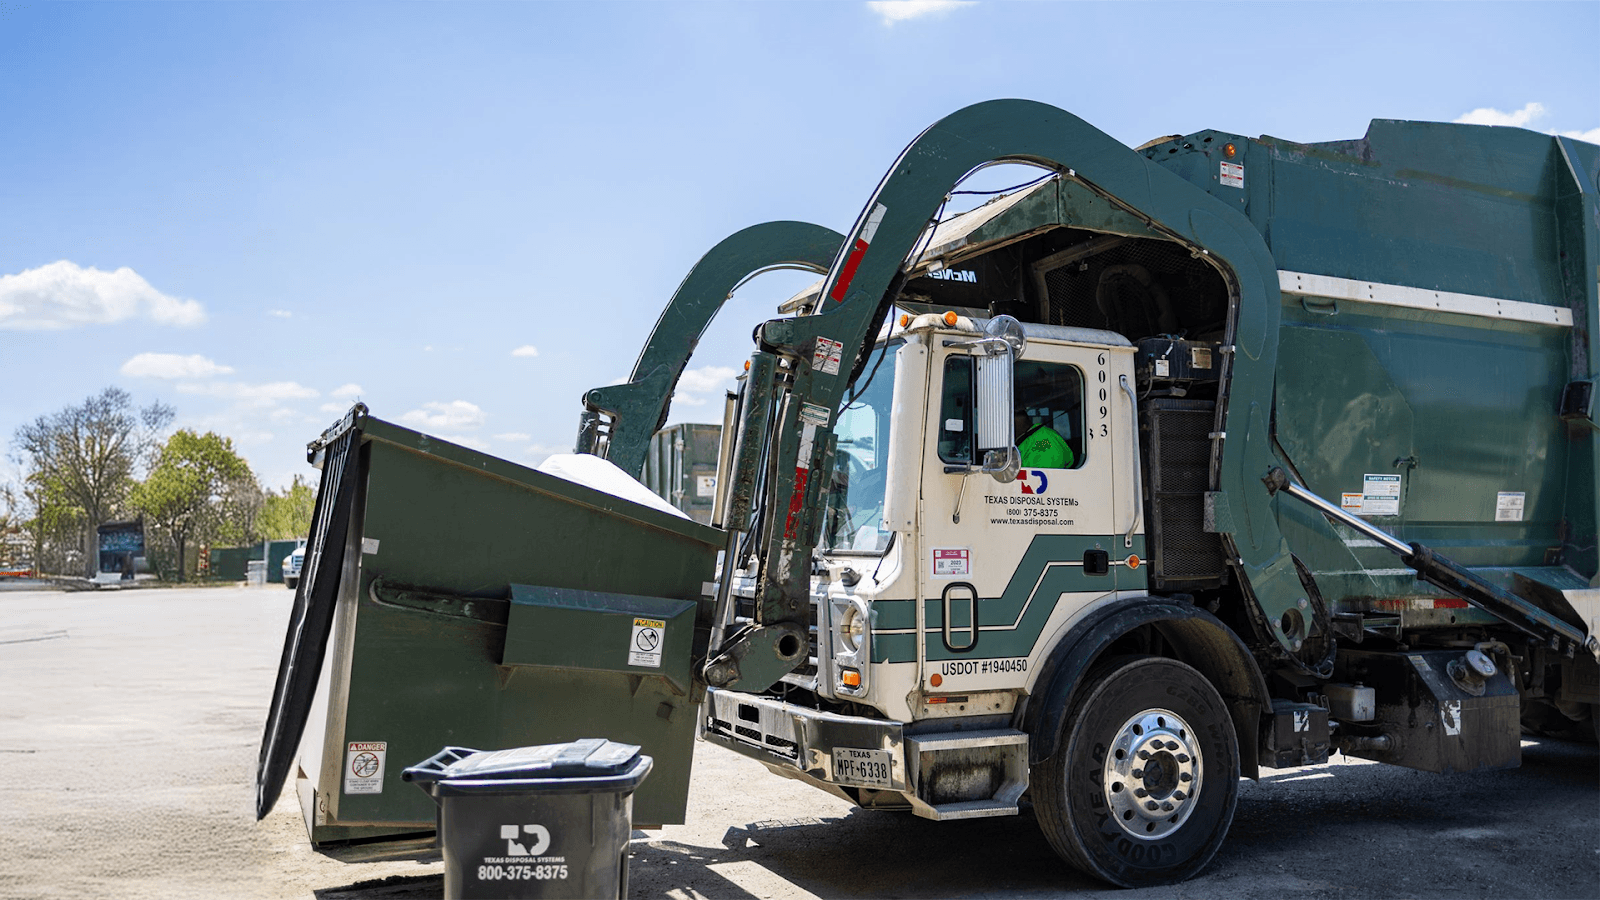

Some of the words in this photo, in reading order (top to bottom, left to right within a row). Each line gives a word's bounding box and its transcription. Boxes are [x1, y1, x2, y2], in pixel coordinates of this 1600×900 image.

[1097, 353, 1108, 437] 60093
[984, 495, 1009, 504] TEXAS
[1010, 496, 1045, 505] DISPOSAL
[1006, 508, 1022, 516] (800)
[1023, 508, 1059, 517] 375-8375
[990, 518, 1074, 526] www.texasdisposal.com
[641, 619, 664, 628] CAUTION
[941, 661, 979, 676] USDOT
[981, 659, 1028, 674] #1940450
[358, 743, 386, 751] DANGER
[849, 750, 871, 759] TEXAS
[1117, 841, 1177, 864] GOOD
[483, 856, 504, 864] TEXAS
[478, 864, 568, 880] 800-375-8375
